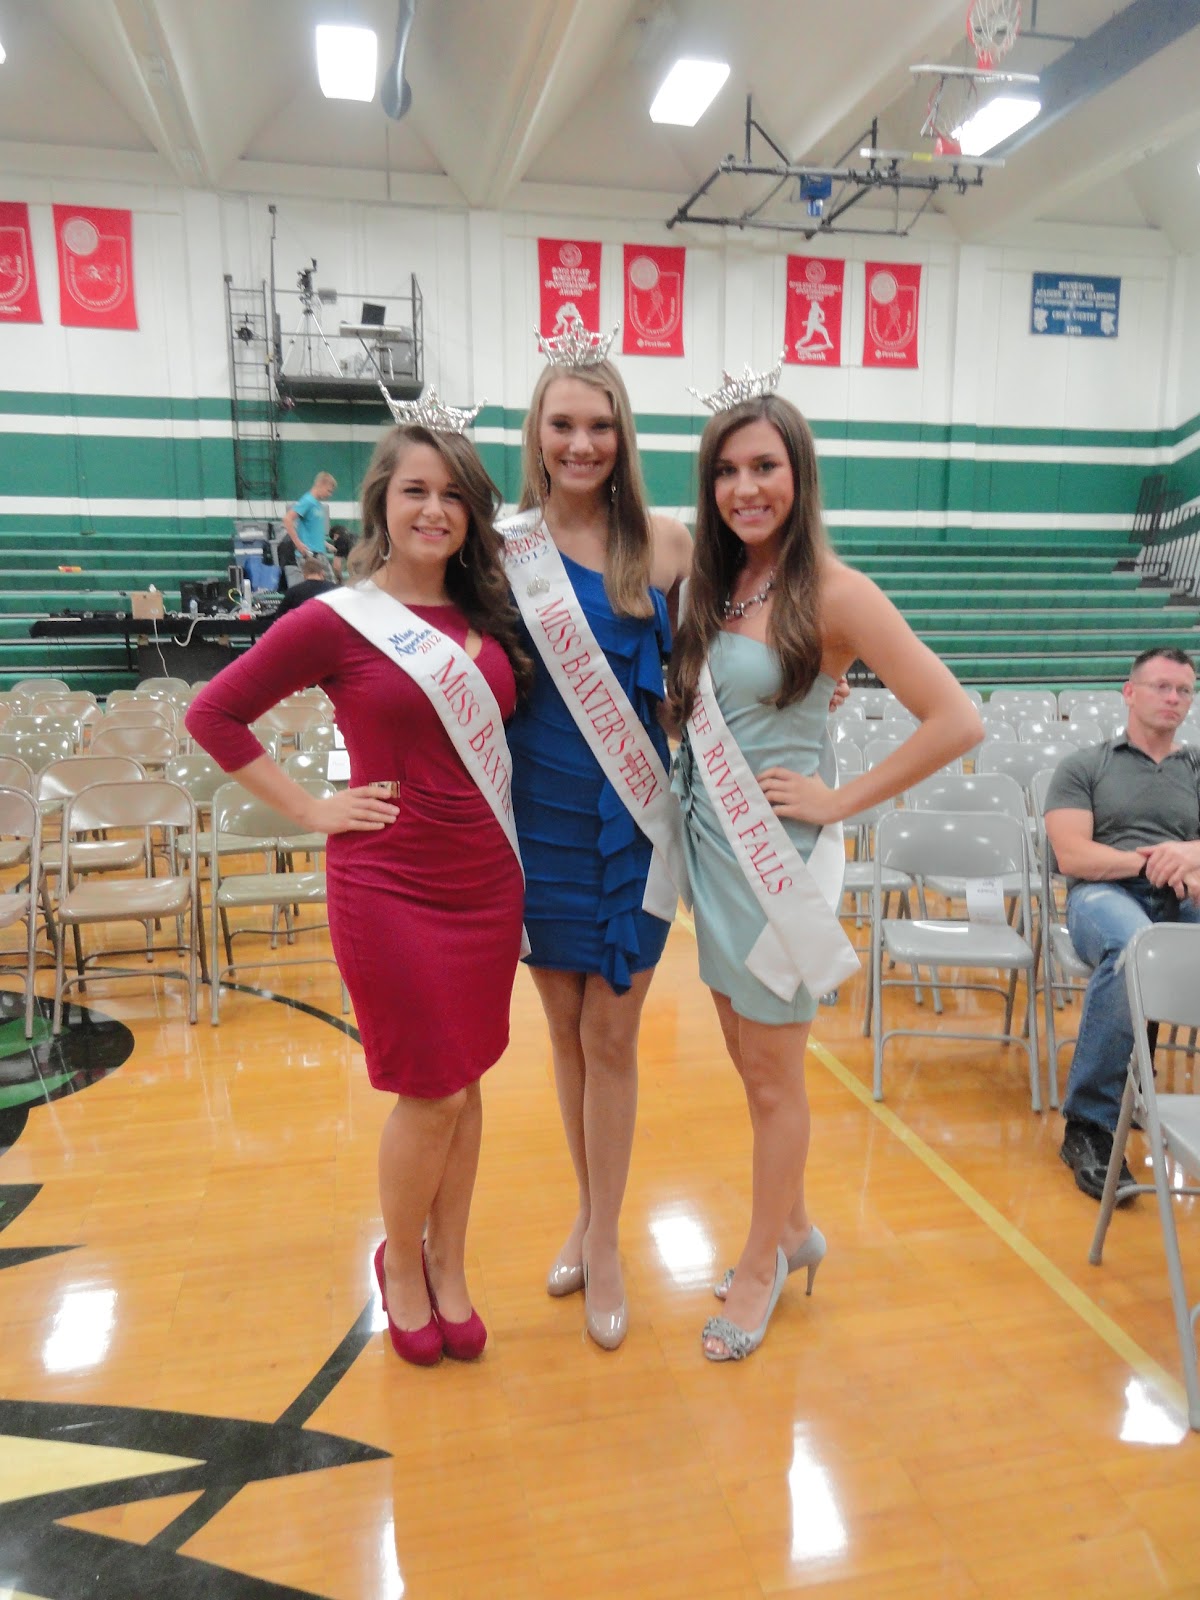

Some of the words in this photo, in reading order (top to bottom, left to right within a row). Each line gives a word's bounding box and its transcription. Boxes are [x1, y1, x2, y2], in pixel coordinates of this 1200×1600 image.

[387, 629, 415, 646] Miss
[417, 634, 442, 655] 2012
[430, 655, 480, 727] MISS
[535, 597, 582, 655] MISS
[561, 650, 635, 756] BAXTER'S
[618, 750, 663, 809] TEEN
[702, 741, 750, 825] RIVER
[738, 820, 793, 896] FALLS
